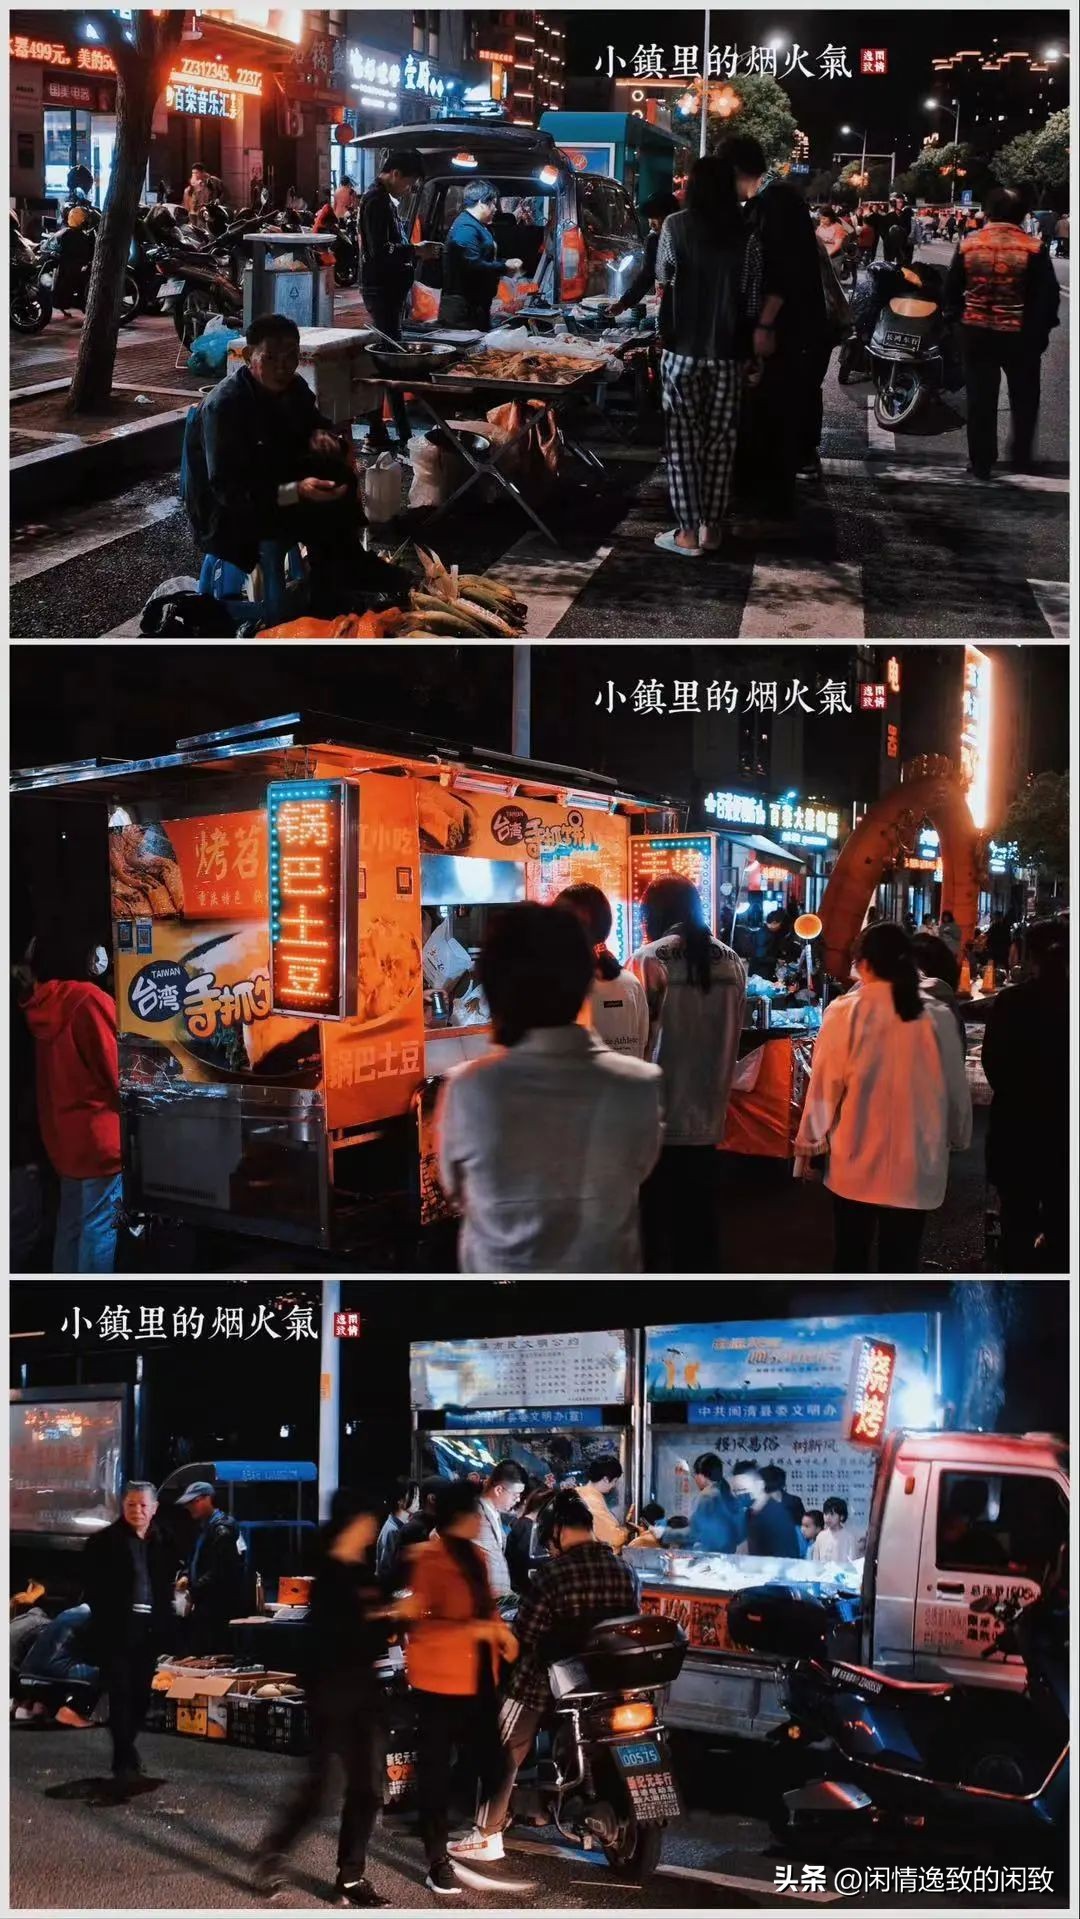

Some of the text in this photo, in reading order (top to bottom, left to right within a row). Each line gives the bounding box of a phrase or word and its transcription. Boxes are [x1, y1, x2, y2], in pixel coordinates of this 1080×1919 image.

[173, 84, 230, 117] 百荣音乐汇
[492, 814, 523, 841] 台湾
[279, 803, 330, 999] 锅巴土豆
[151, 966, 181, 979] TAIWAN
[131, 976, 180, 1017] 台湾
[327, 1040, 420, 1088] 锅巴土豆
[855, 1348, 891, 1438] 烧烤
[699, 1404, 837, 1418] 中共闽清县委文明办
[623, 1750, 657, 1765] 00575
